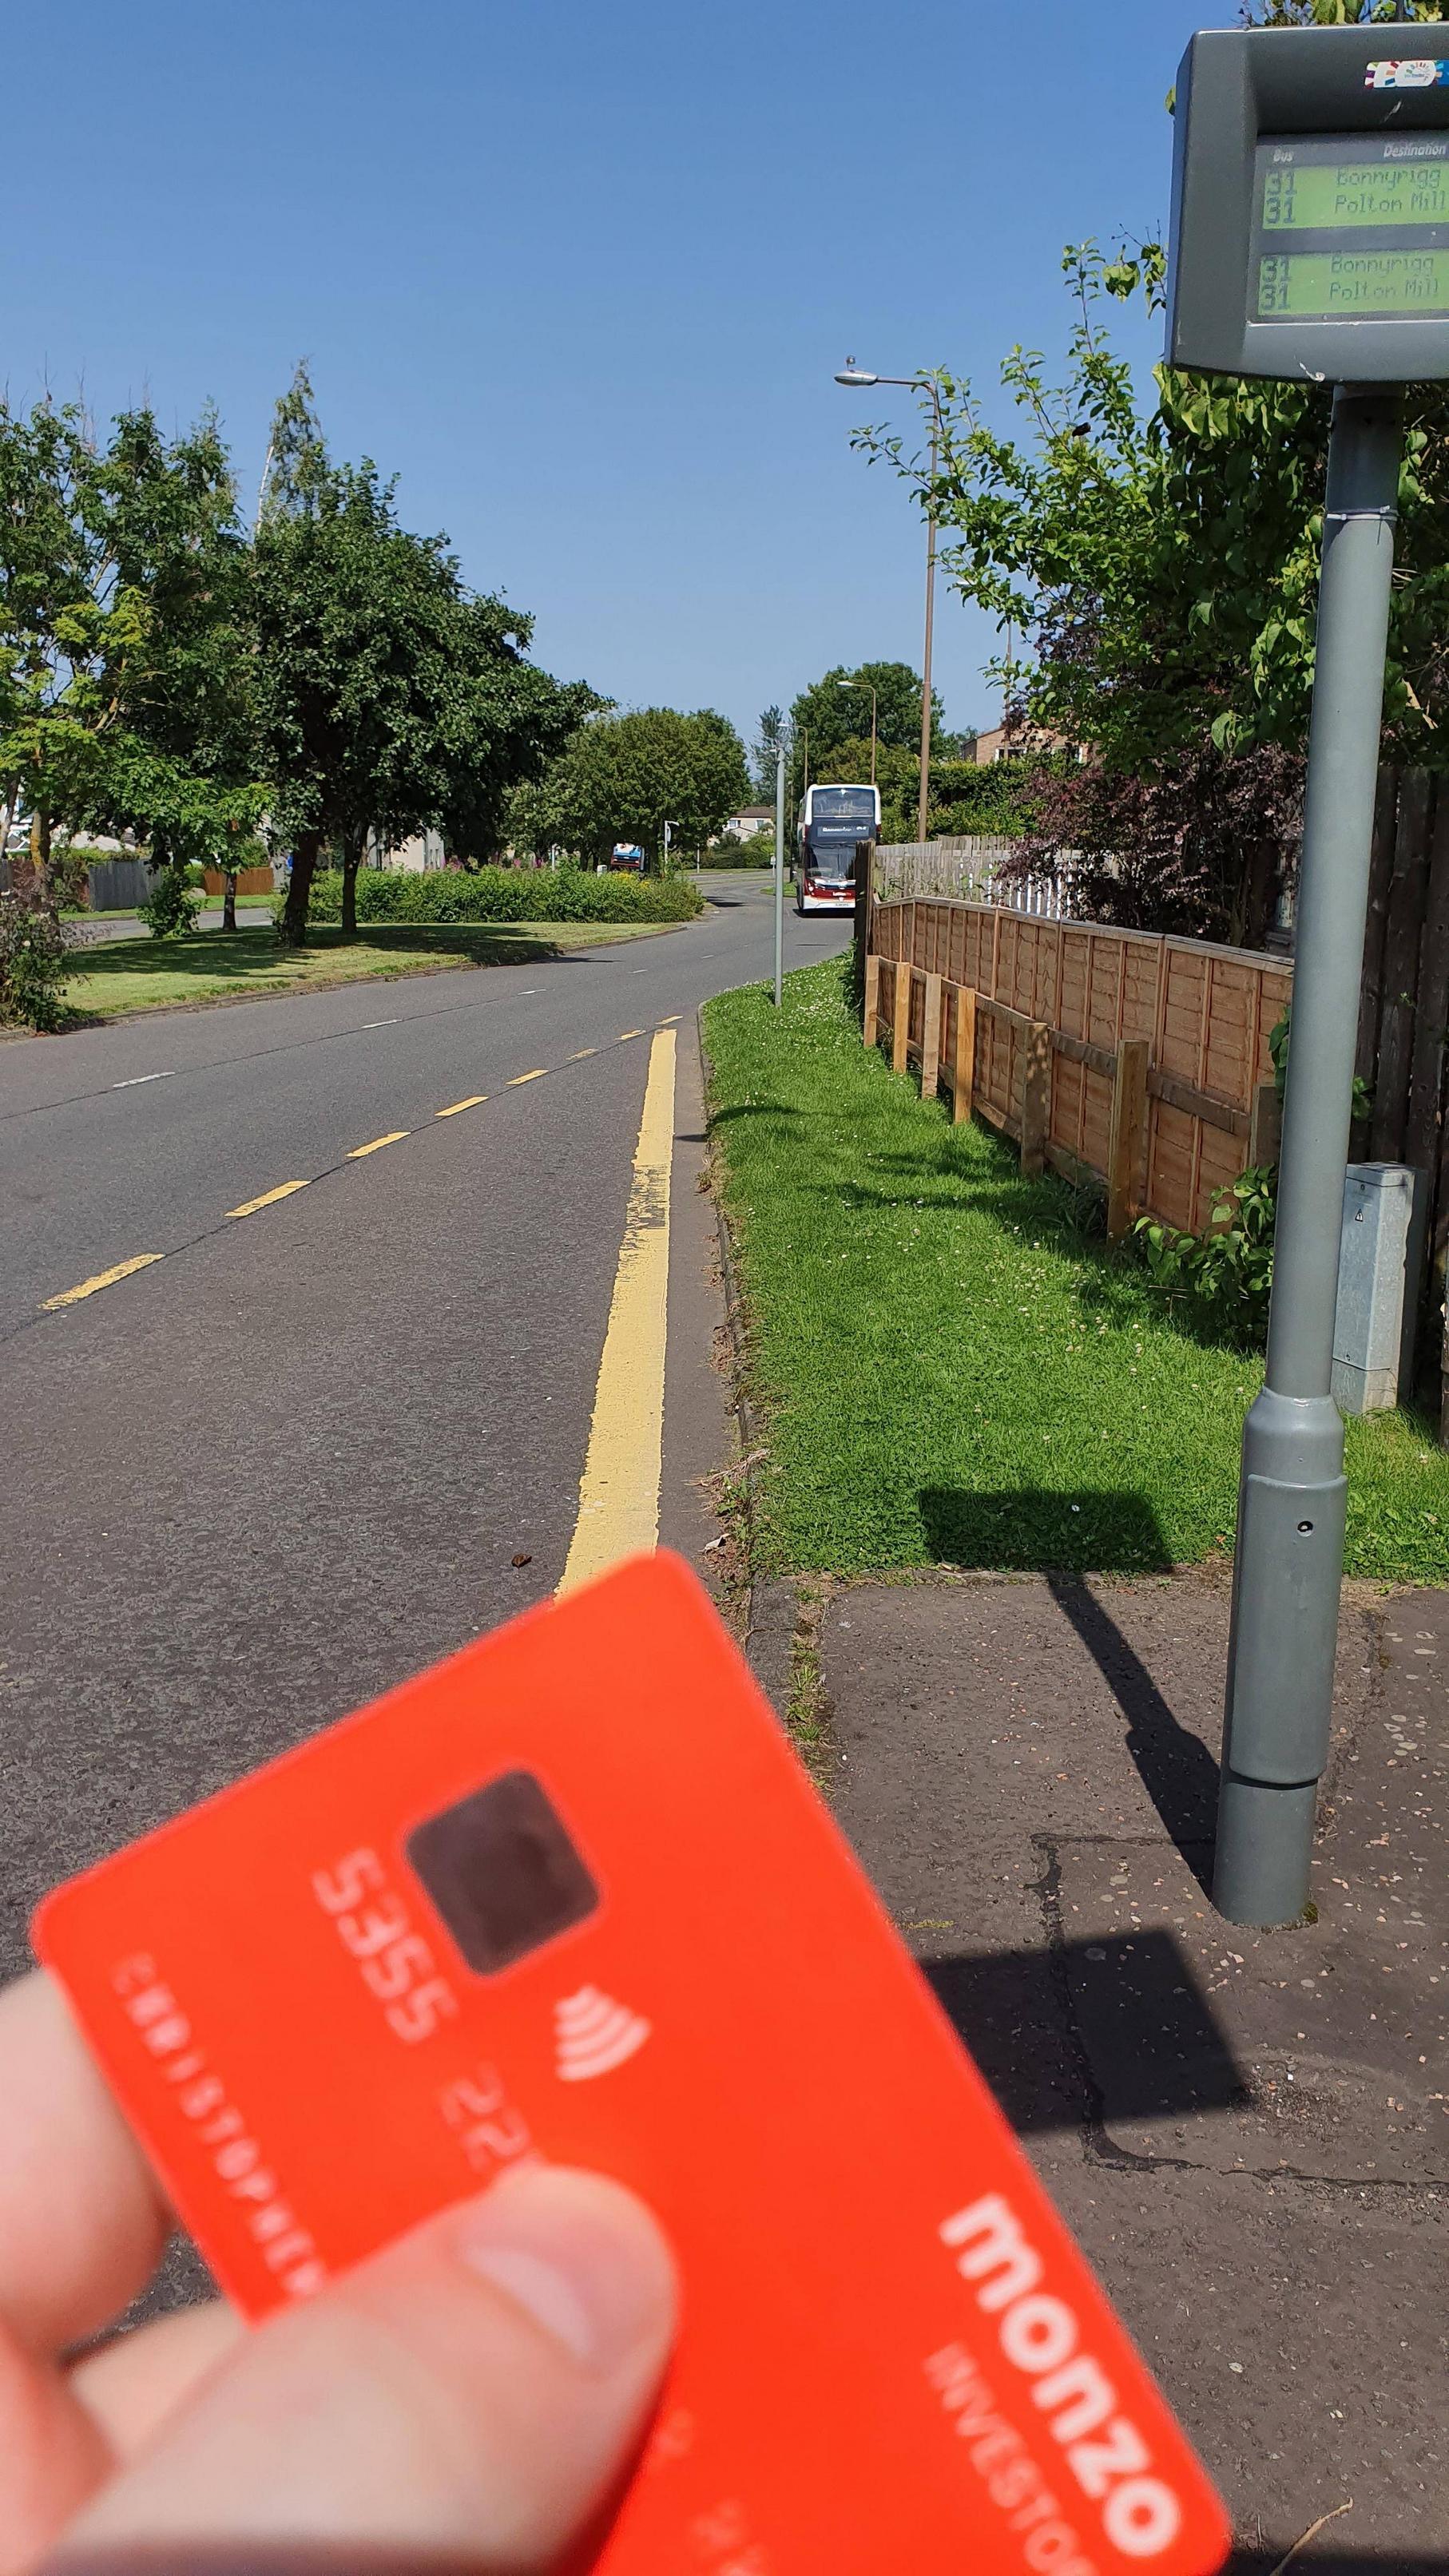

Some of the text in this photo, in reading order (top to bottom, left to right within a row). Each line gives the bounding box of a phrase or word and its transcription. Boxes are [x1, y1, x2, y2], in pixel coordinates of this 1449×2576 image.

[1273, 144, 1447, 162] Bus Destination
[1265, 167, 1442, 196] 31 Bonnyrigg
[1264, 190, 1446, 224] 31 Polton Mill
[1261, 254, 1435, 283] 31 Bonnyrigg
[1260, 277, 1439, 311] 31 Polton Mill
[312, 1849, 459, 2043] 5355
[939, 2193, 1182, 2557] monzo
